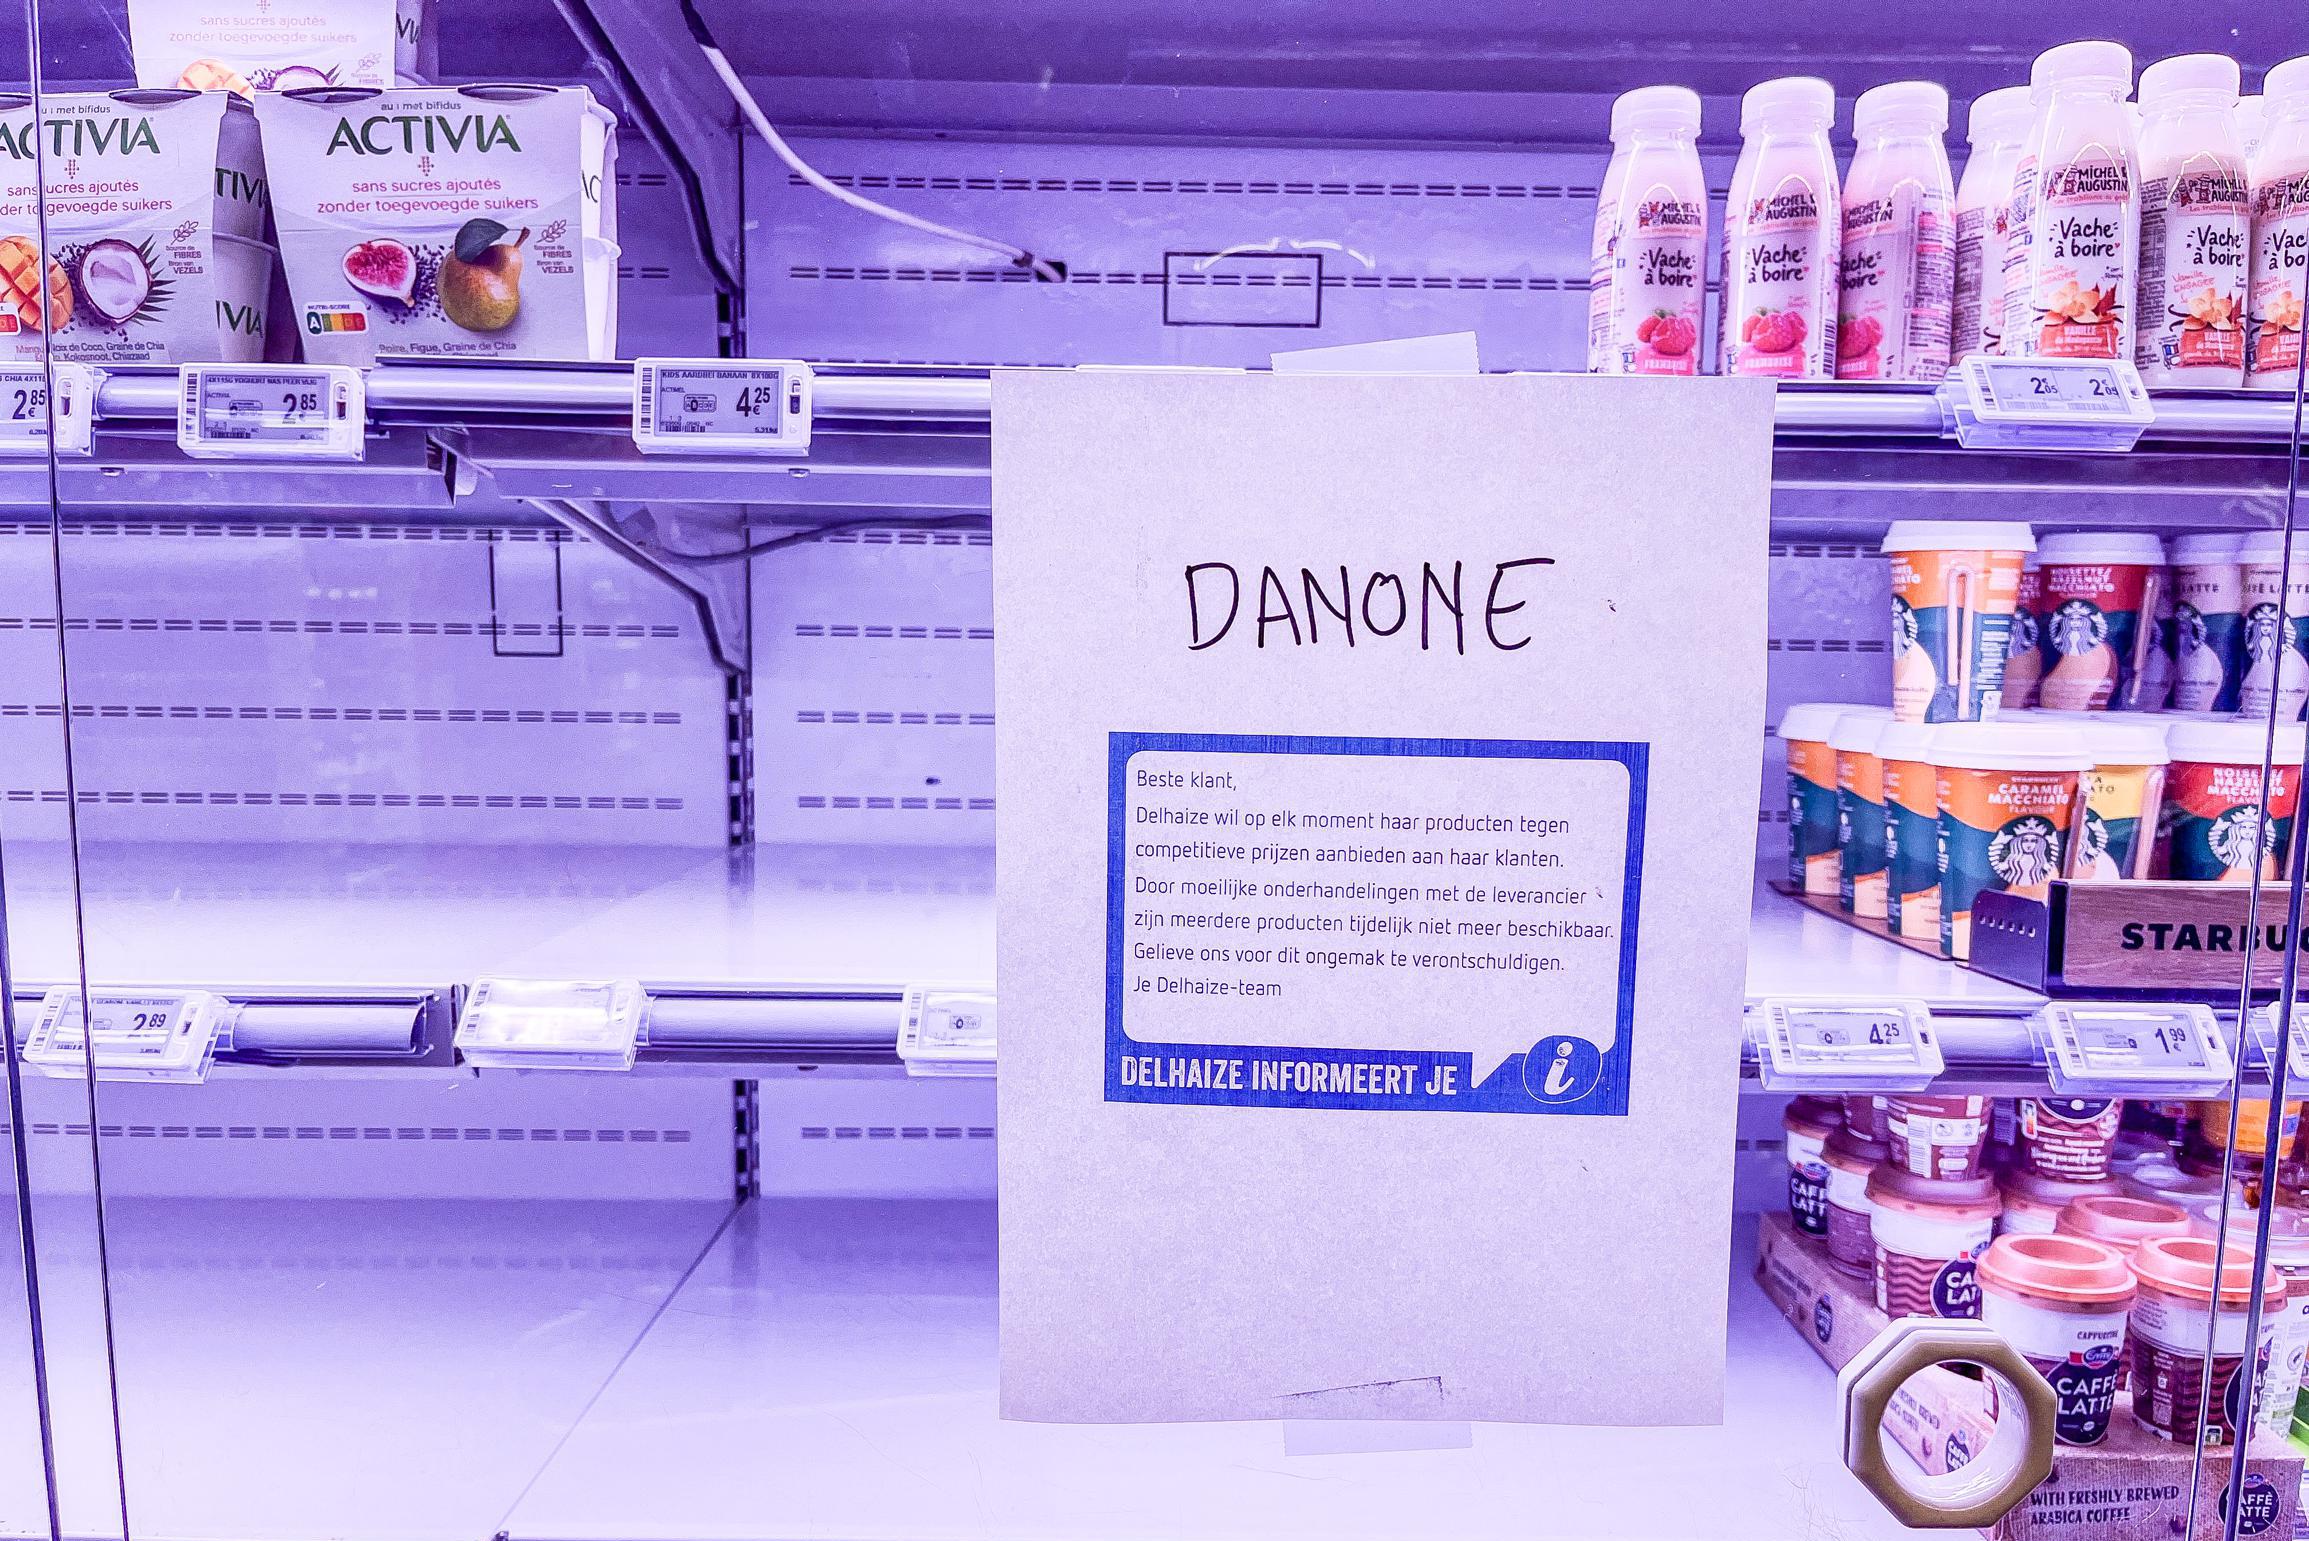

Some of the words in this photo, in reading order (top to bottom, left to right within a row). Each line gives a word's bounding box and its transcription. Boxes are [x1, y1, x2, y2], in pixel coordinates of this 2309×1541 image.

[56, 106, 75, 115] met
[78, 104, 111, 114] bifidus
[403, 102, 423, 111] met
[426, 101, 462, 111] bifidus
[326, 113, 523, 156] ACTIVIA
[7, 185, 37, 197] sans
[45, 182, 85, 195] ucres
[88, 179, 139, 195] ajoutés
[352, 181, 388, 194] sans
[391, 180, 442, 193] sucres
[446, 178, 502, 195] ajoutés
[2077, 178, 2128, 194] AUGUSTIN
[27, 200, 119, 217] togevoegde
[122, 198, 173, 211] suikers
[317, 199, 371, 214] zonder
[375, 199, 480, 216] toegevoegde
[484, 197, 539, 211] suikers
[1765, 205, 1817, 221] AUGUSTIN
[2060, 216, 2115, 241] Vache
[2197, 225, 2242, 249] Vache
[1649, 247, 1693, 269] Vache
[1751, 244, 1803, 267] Vache
[2055, 240, 2065, 259] à
[2071, 238, 2115, 258] boire
[2193, 247, 2203, 265] à
[2209, 246, 2243, 267] boire
[2268, 252, 2279, 270] à
[1645, 269, 1654, 286] à
[1658, 267, 1694, 287] boire
[1762, 264, 1805, 284] boire
[310, 316, 320, 329] A
[146, 341, 165, 350] Chia
[443, 342, 477, 352] Graine
[479, 342, 492, 351] de
[493, 341, 517, 350] Chia
[1185, 557, 1556, 656] DANONE
[1138, 770, 1184, 788] Beste
[1191, 771, 1237, 791] klant,
[1998, 783, 2065, 795] CARAMEL
[1987, 793, 2069, 805] MACCHIATO
[2207, 785, 2286, 797] MACCHTO
[1137, 806, 1209, 825] Delhaize
[1214, 808, 1239, 826] wil
[1244, 813, 1265, 831] op
[1272, 810, 1296, 827] elk
[1302, 812, 1374, 829] moment
[1381, 812, 1419, 830] haar
[1425, 813, 1513, 835] producten
[1520, 815, 1569, 838] tegen
[1136, 841, 1245, 863] competitieve
[1251, 843, 1309, 865] prijzen
[1315, 845, 1406, 864] aanbieden
[1412, 850, 1443, 865] aan
[1450, 847, 1489, 866] haar
[1495, 848, 1564, 868] klanten.
[1136, 876, 1174, 894] Door
[1181, 878, 1257, 900] moeilijke
[1263, 881, 1419, 905] onderhandelingen
[1426, 885, 1460, 902] met
[1465, 885, 1486, 903] de
[1493, 886, 1587, 905] leverancier
[1134, 909, 1164, 931] zijn
[1170, 912, 1251, 929] meerdere
[1257, 913, 1343, 934] producten
[1350, 915, 1413, 938] tijdelijk
[1418, 917, 1452, 935] niet
[1458, 922, 1502, 936] meer
[1508, 919, 1615, 938] beschikbaar.
[1134, 942, 1194, 961] Gelieve
[1200, 948, 1230, 962] ons
[1235, 949, 1273, 963] voor
[1277, 946, 1300, 964] dit
[1305, 949, 1385, 969] ongemak
[1391, 949, 1407, 967] te
[1412, 952, 1565, 975] verontschuldigen.
[1133, 975, 1151, 993] Je
[1157, 976, 1281, 996] Delhaize-team
[149, 1013, 167, 1028] 89
[1883, 1023, 1900, 1037] 25
[1121, 1055, 1244, 1090] DELHAIZE
[1252, 1060, 1419, 1096] INFORMEERT
[1425, 1064, 1457, 1096] JE
[2057, 1392, 2114, 1416] LATTE
[2031, 1489, 2066, 1507] WITH
[2068, 1488, 2125, 1505] FRESHLY
[2126, 1485, 2180, 1502] BREWED
[2240, 1490, 2273, 1507] AFFÈ
[2031, 1508, 2083, 1526] ARABICA
[2086, 1506, 2131, 1524] COFFEE
[2240, 1504, 2271, 1519] ATTE
